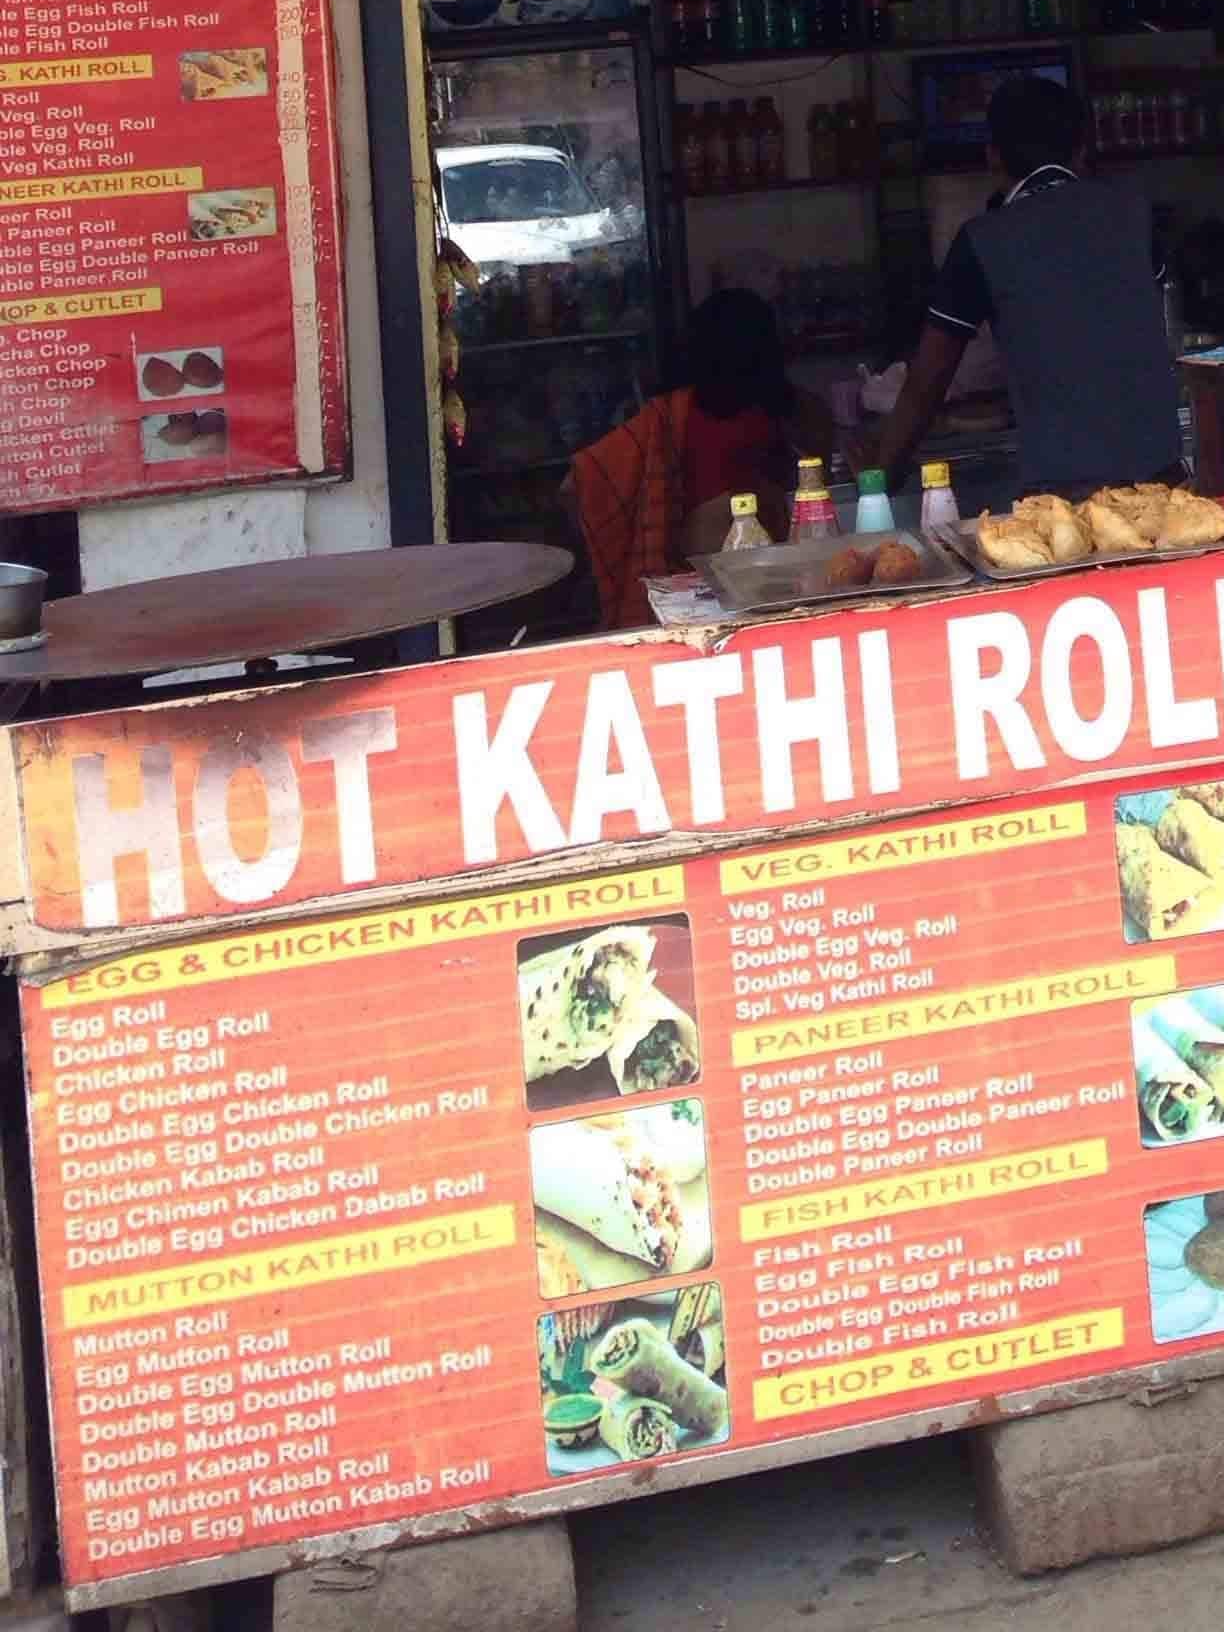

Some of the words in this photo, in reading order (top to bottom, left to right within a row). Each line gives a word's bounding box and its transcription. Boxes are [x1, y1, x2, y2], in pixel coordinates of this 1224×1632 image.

[25, 23, 61, 39] Egg
[68, 18, 132, 35] Double
[139, 15, 177, 30] Fish
[184, 13, 218, 27] Roll
[43, 155, 91, 172] Kathi
[98, 152, 133, 167] Roll
[63, 177, 124, 196] KATHI
[131, 172, 185, 190] ROLL
[8, 223, 73, 241] Paneer
[80, 220, 116, 234] Roll
[44, 302, 57, 316] &
[65, 293, 146, 315] CUTLET
[71, 706, 396, 928] HOT
[452, 630, 902, 864] KATHI
[741, 849, 833, 884] VEG.
[847, 828, 958, 867] KATHI
[970, 809, 1070, 846] ROLL
[730, 925, 773, 946] Egg
[831, 903, 874, 927] Roll
[782, 887, 825, 911] Roll
[66, 959, 163, 998] EGG
[178, 950, 207, 977] &
[221, 915, 416, 971] CHICKEN
[431, 893, 551, 936] KATHI
[567, 873, 672, 913] ROLL
[50, 1016, 104, 1040] Egg
[112, 999, 165, 1026] Roll
[735, 997, 776, 1020] Spl.
[783, 991, 824, 1010] Veg
[830, 976, 885, 1002] Kathi
[891, 967, 933, 992] Roll
[753, 1007, 910, 1057] PANEER
[923, 985, 1035, 1026] KATHI
[1047, 965, 1145, 1004] ROLL
[52, 1034, 148, 1067] Double
[156, 1026, 209, 1050] Egg
[216, 1010, 269, 1038] Roll
[54, 1061, 165, 1095] Chicken
[172, 1047, 225, 1075] Roll
[740, 1063, 826, 1092] Paneer
[834, 1050, 882, 1074] Roll
[58, 1120, 154, 1154] Double
[162, 1112, 216, 1136] Egg
[223, 1090, 329, 1124] Chicken
[336, 1076, 388, 1104] Roll
[62, 1177, 172, 1210] Chicken
[180, 1157, 265, 1189] Kabab
[271, 1146, 324, 1173] Roll
[748, 1163, 836, 1193] Double
[843, 1146, 928, 1175] Paneer
[935, 1133, 982, 1157] Roll
[762, 1193, 850, 1231] FISH
[863, 1170, 976, 1212] KATHI
[989, 1148, 1089, 1188] ROLL
[65, 1217, 118, 1241] Egg
[125, 1196, 229, 1228] Chimen
[236, 1176, 320, 1208] Kabab
[327, 1164, 378, 1192] Roll
[84, 1261, 255, 1318] MUTTON
[268, 1238, 377, 1282] KATHI
[393, 1217, 490, 1258] ROLL
[754, 1268, 817, 1292] Egg
[826, 1252, 894, 1278] Fish
[903, 1236, 963, 1263] Roll
[73, 1326, 166, 1356] Mutton
[174, 1310, 227, 1338] Roll
[75, 1363, 129, 1387] Egg
[136, 1343, 230, 1373] Mutton
[237, 1327, 288, 1356] Roll
[778, 1362, 895, 1408] CHOP
[907, 1355, 933, 1381] &
[950, 1320, 1101, 1373] CUTLET
[81, 1439, 177, 1473] Double
[184, 1421, 278, 1453] Mutton
[284, 1405, 336, 1433] Roll
